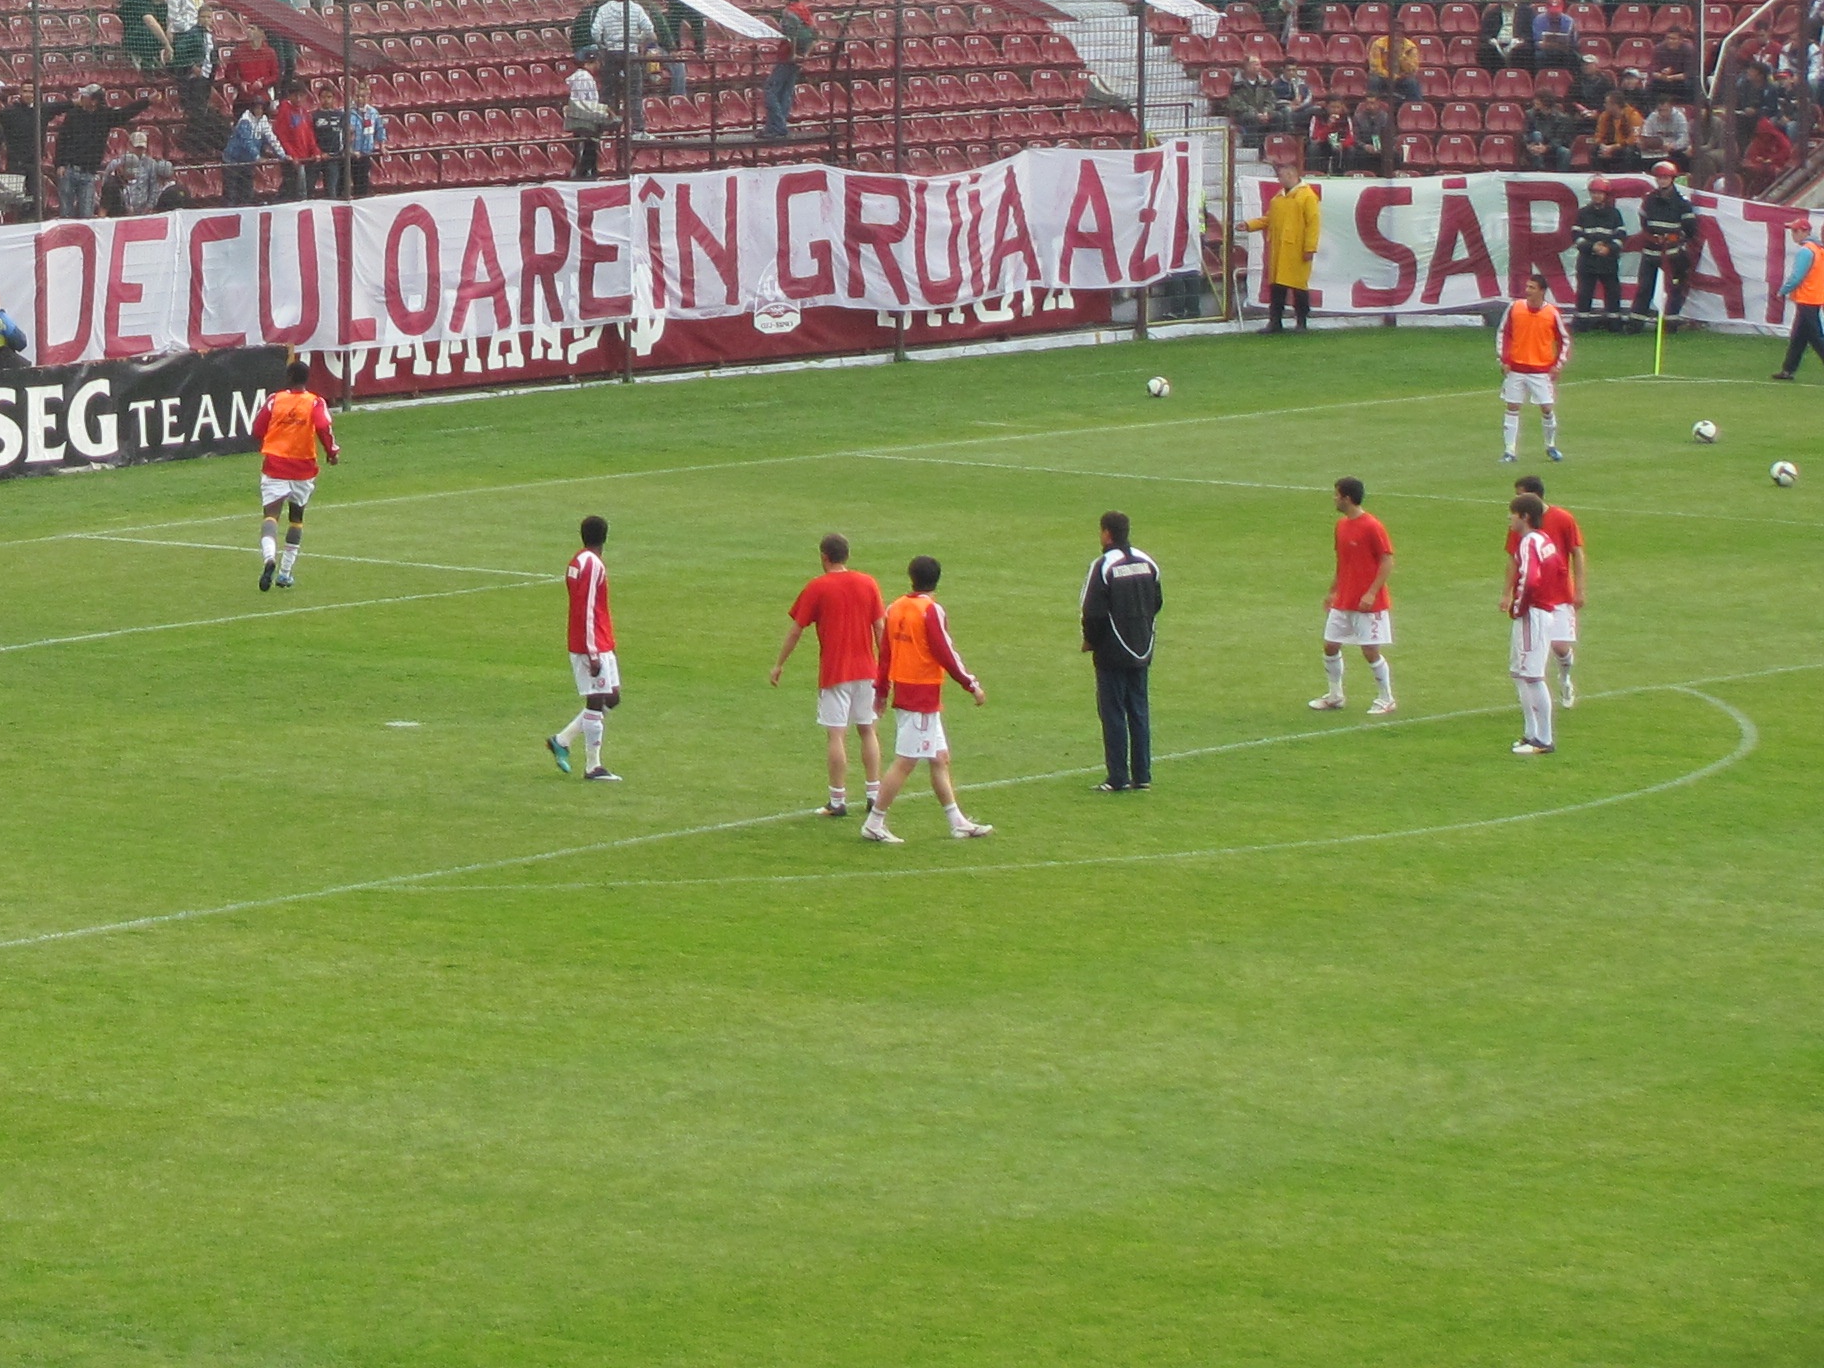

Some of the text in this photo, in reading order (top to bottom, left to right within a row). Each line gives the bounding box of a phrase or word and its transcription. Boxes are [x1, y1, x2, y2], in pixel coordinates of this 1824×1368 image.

[34, 218, 168, 366] DE
[187, 183, 632, 350] CULOARE
[776, 165, 1042, 308] GRUIA
[128, 388, 268, 448] TEAM
